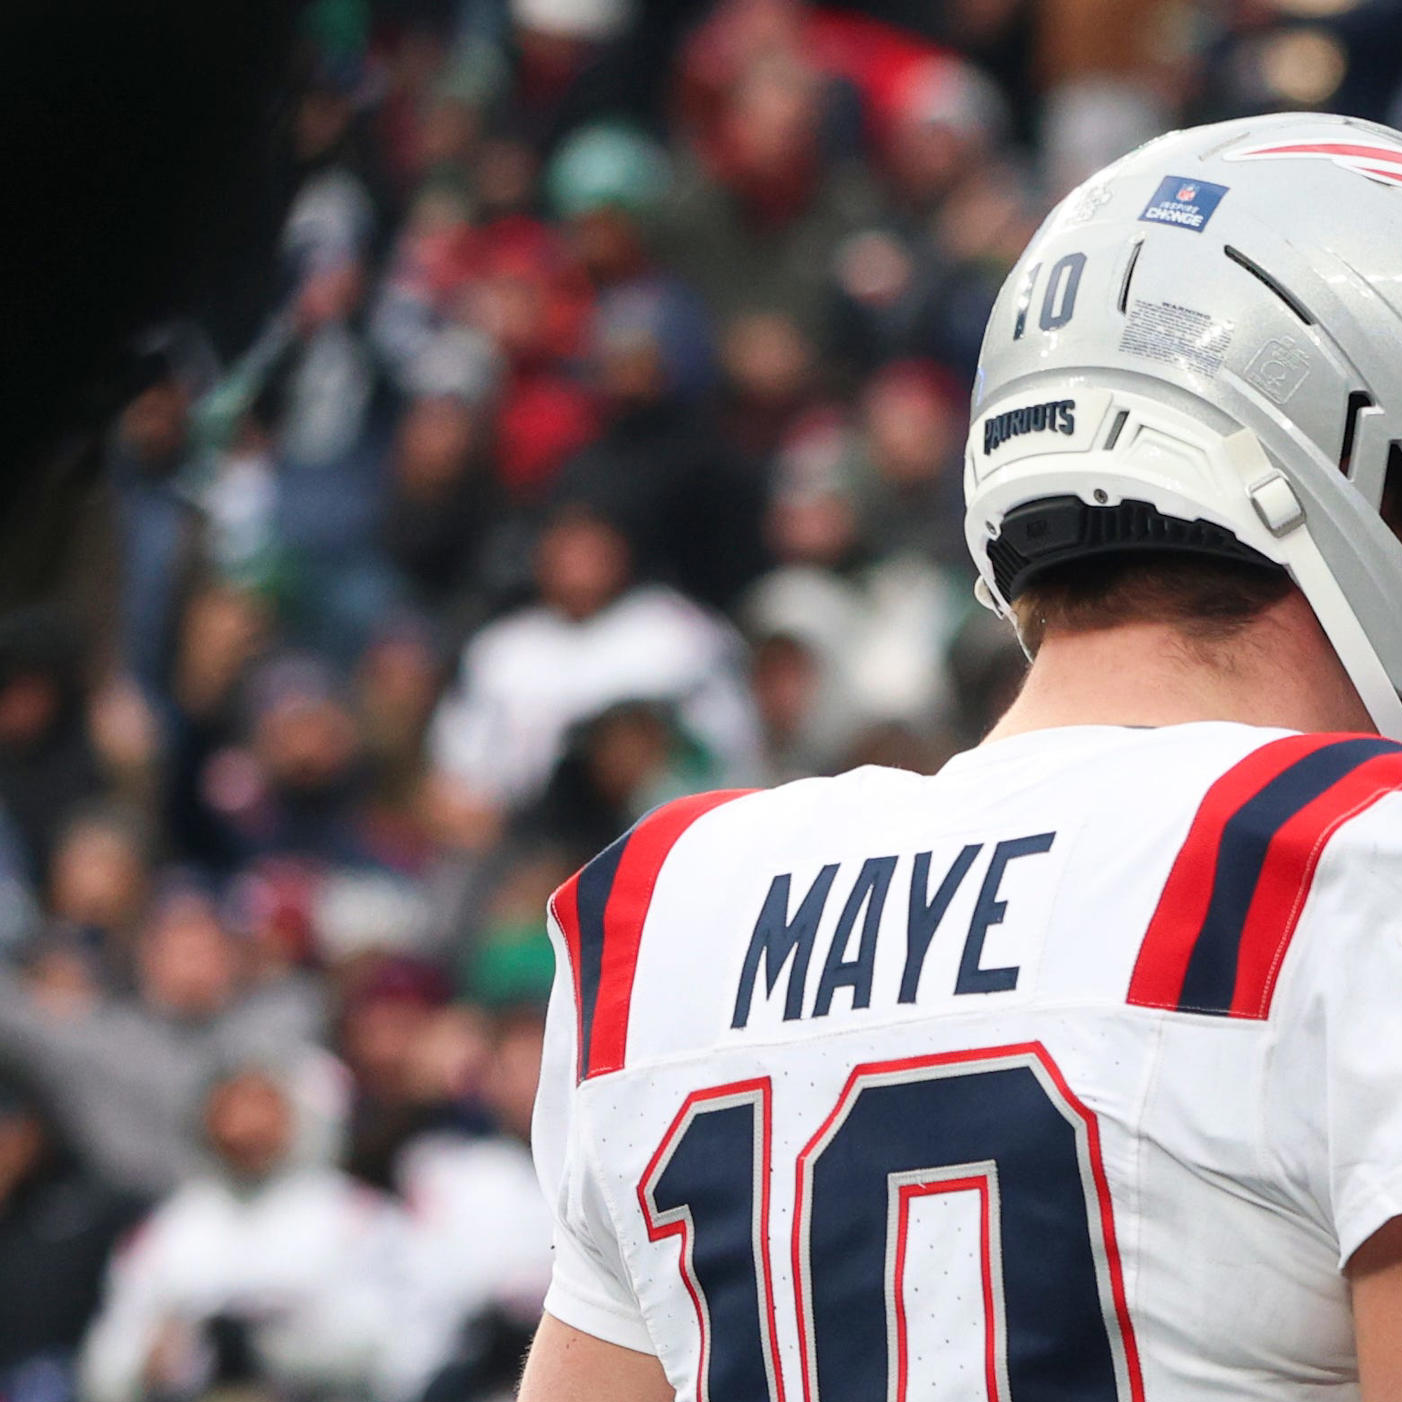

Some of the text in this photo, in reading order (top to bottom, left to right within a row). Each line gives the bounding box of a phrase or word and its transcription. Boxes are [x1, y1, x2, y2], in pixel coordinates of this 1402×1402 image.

[1145, 207, 1204, 227] CHANGE
[1013, 252, 1087, 341] 10
[983, 399, 1076, 455] PATRIOTS
[730, 832, 1056, 1029] MAYE
